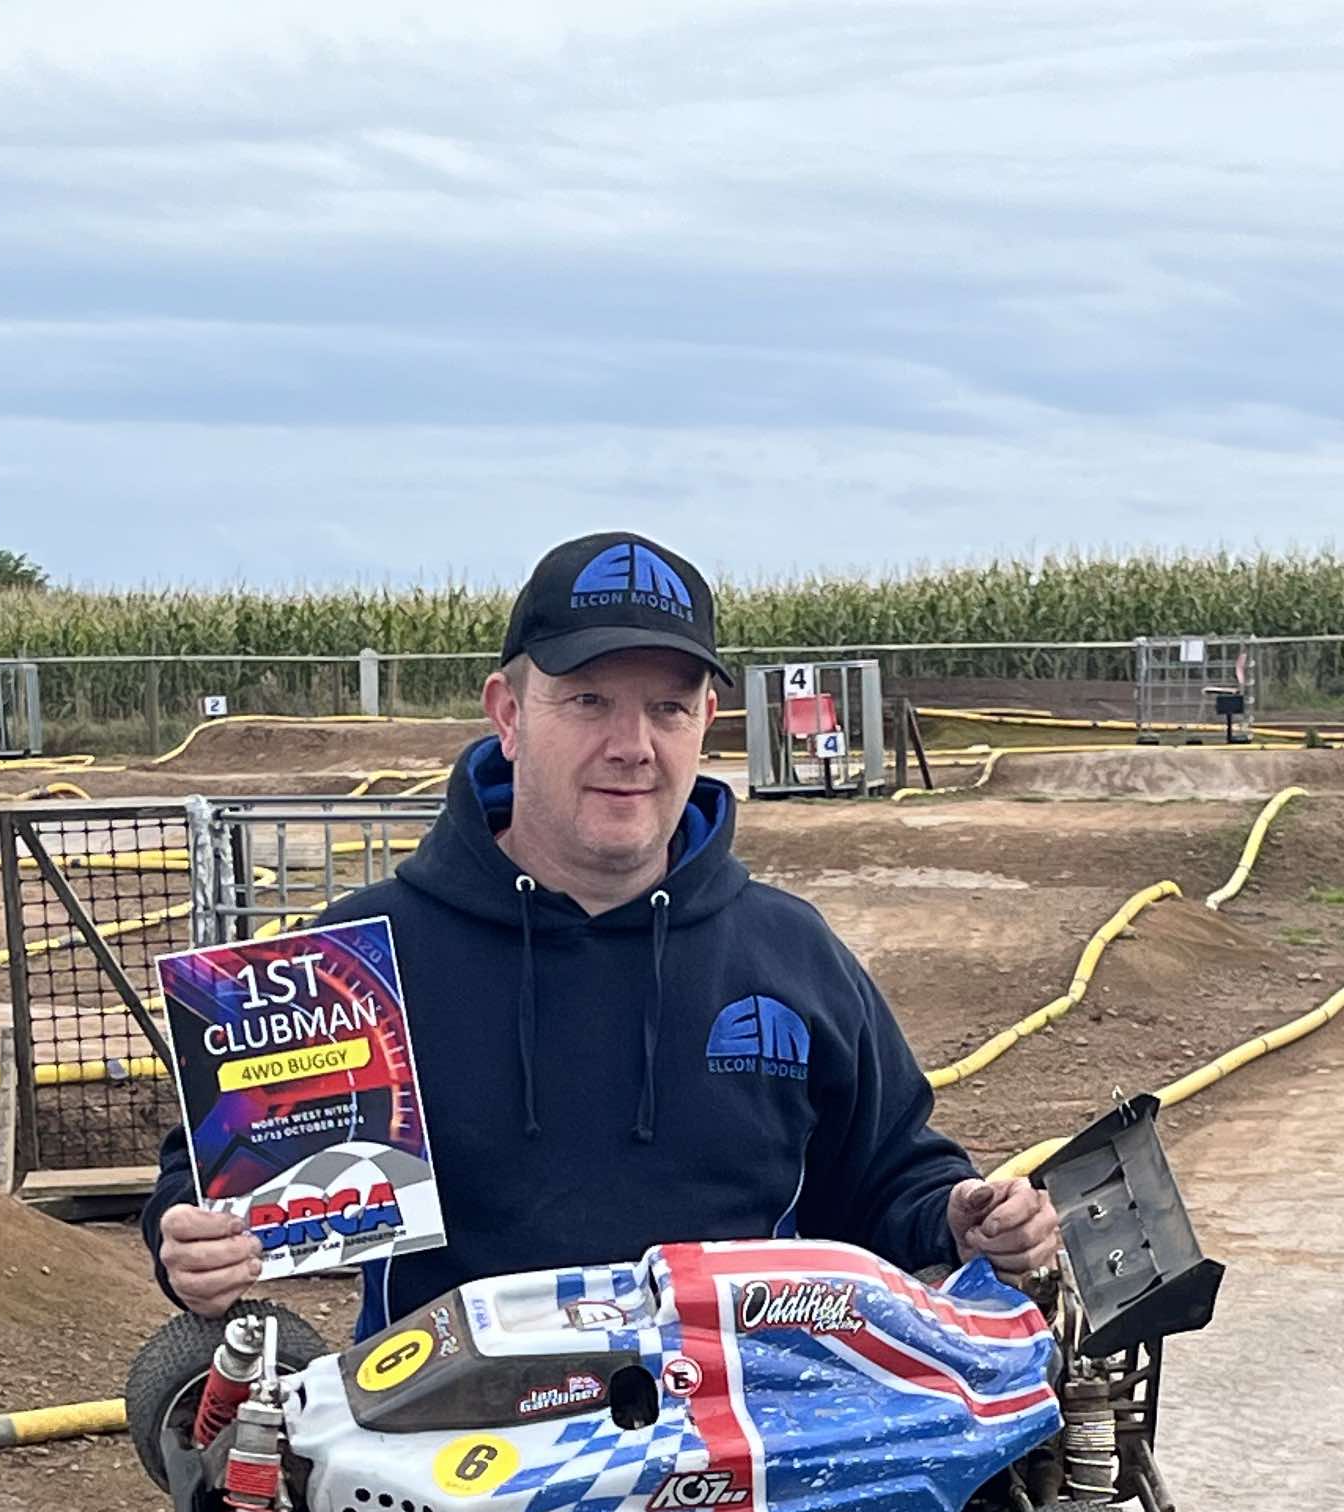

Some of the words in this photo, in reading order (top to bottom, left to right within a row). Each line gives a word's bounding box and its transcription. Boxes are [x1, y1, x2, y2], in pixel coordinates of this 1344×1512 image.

[570, 592, 624, 610] ELCON
[790, 668, 807, 690] 4
[210, 698, 220, 711] 2
[235, 952, 324, 1011] 1ST
[203, 996, 379, 1056] CLUBMAN
[241, 1060, 284, 1082] 4WD
[288, 1049, 349, 1074] BUGGY
[283, 1119, 335, 1137] OCTOBER
[249, 1181, 404, 1252] BRCA
[455, 1444, 498, 1481] 6
